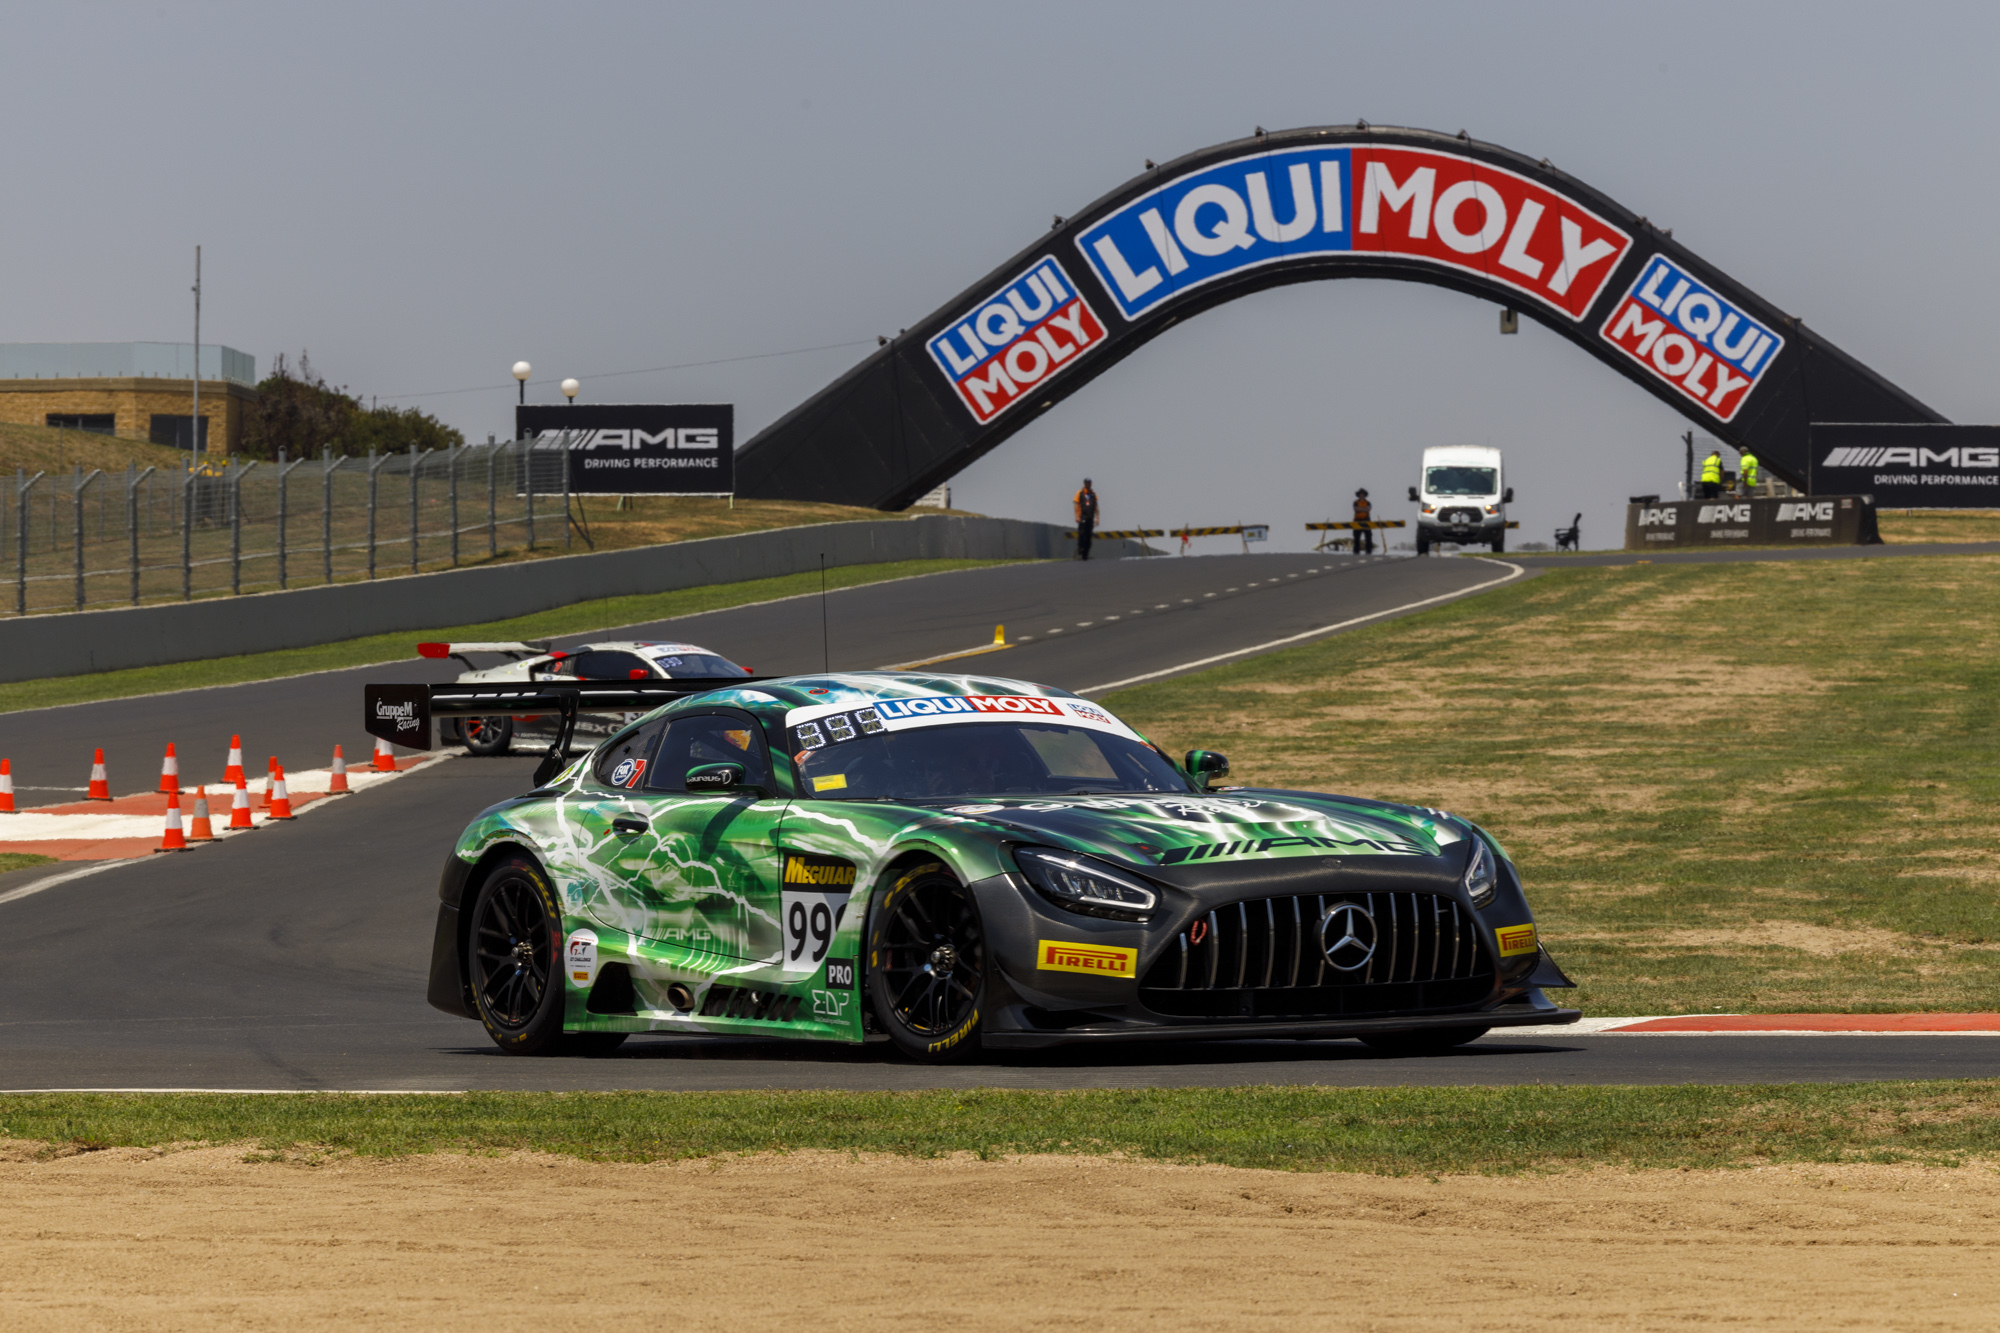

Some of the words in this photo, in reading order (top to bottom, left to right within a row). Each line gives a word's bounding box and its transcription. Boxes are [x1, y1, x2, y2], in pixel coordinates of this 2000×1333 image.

[1092, 160, 1344, 302] LIQUI
[1358, 160, 1618, 296] MOLY
[936, 264, 1069, 376] LIQUI
[1637, 263, 1773, 373] LIQUI
[964, 300, 1090, 415] MOLY
[1610, 302, 1750, 408] MOLY
[585, 427, 719, 450] AMG
[584, 458, 631, 469] DRIVING
[633, 457, 719, 469] PERFORMANCE
[1874, 446, 2000, 468] AMG
[1874, 474, 1918, 485] DRIVING
[1920, 474, 1999, 485] PERFORMANCE
[1713, 503, 1751, 523] AMG
[1793, 502, 1834, 521] AMG
[376, 701, 413, 719] GruppeM
[878, 697, 974, 718] LIQUI
[969, 697, 1055, 713] MOLY
[396, 717, 420, 732] Racing
[616, 764, 631, 775] FOX
[1500, 929, 1534, 952] PIRELLI
[1046, 946, 1128, 971] PIRELLI
[828, 965, 852, 985] PRO
[928, 1008, 979, 1053] PIRELLI
